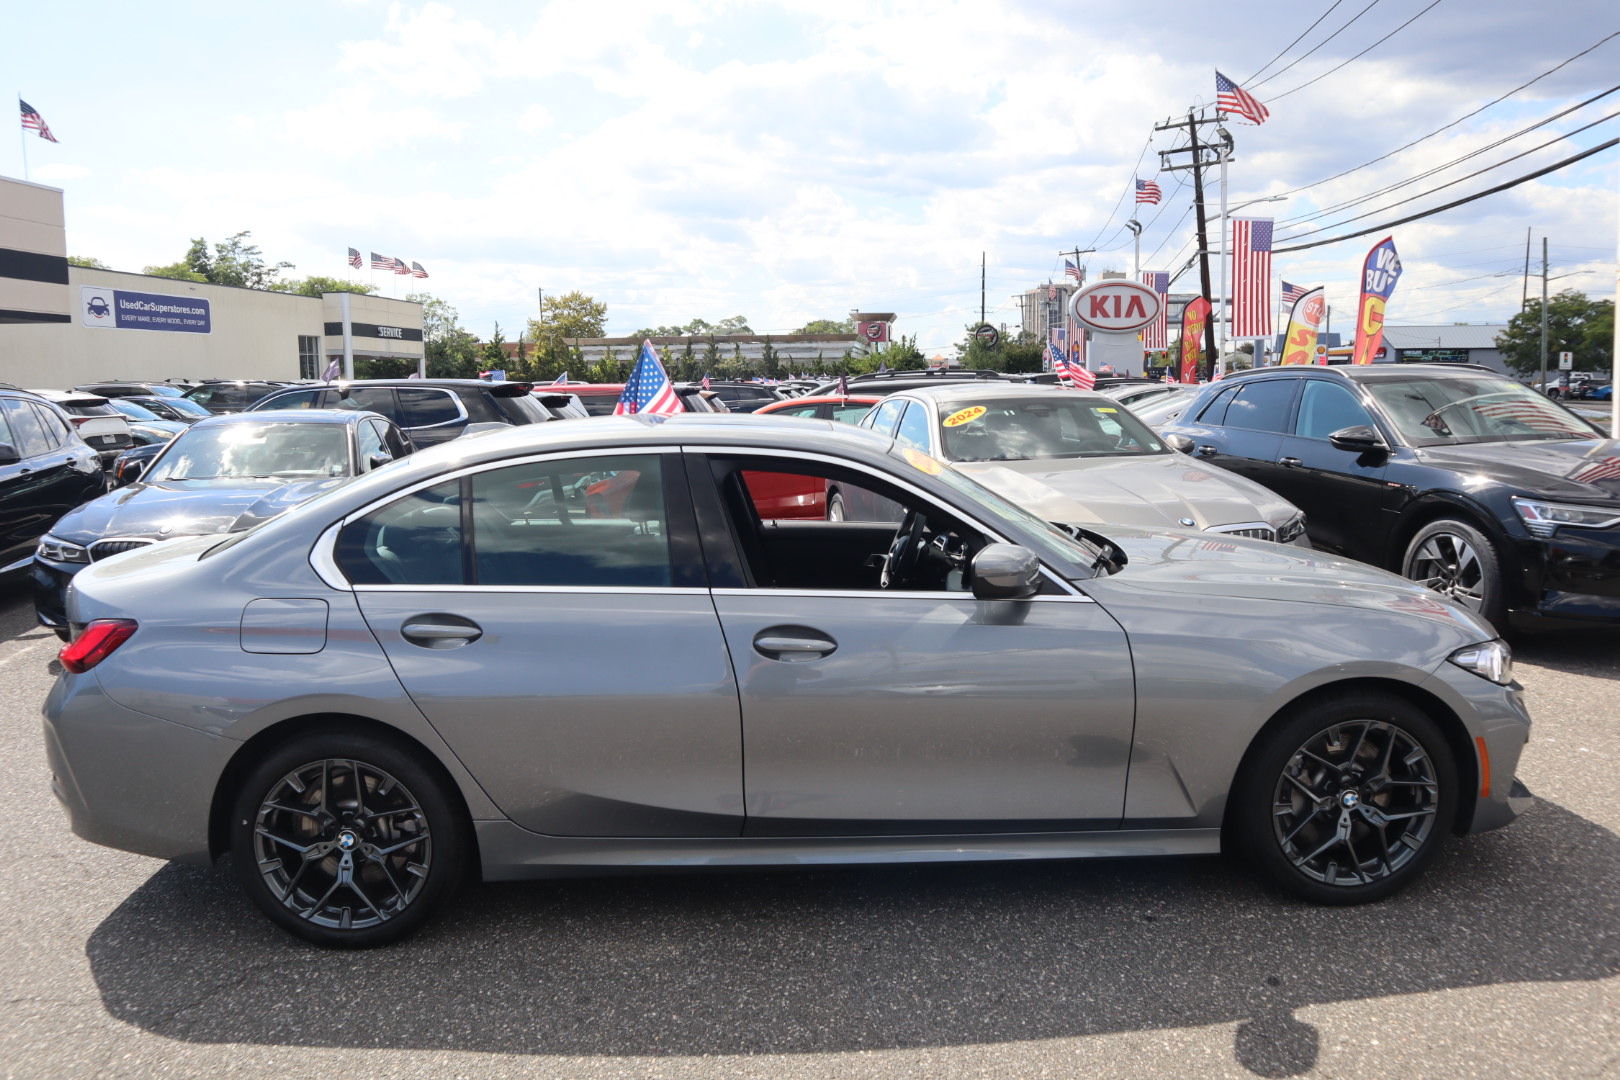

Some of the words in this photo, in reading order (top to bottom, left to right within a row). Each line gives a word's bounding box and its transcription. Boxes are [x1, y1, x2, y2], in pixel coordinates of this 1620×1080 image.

[120, 299, 206, 315] UsedCarSuperstores.com
[1089, 295, 1147, 318] KIA
[152, 316, 167, 324] EVERY
[378, 326, 403, 339] SERVICE
[948, 407, 982, 426] 2024
